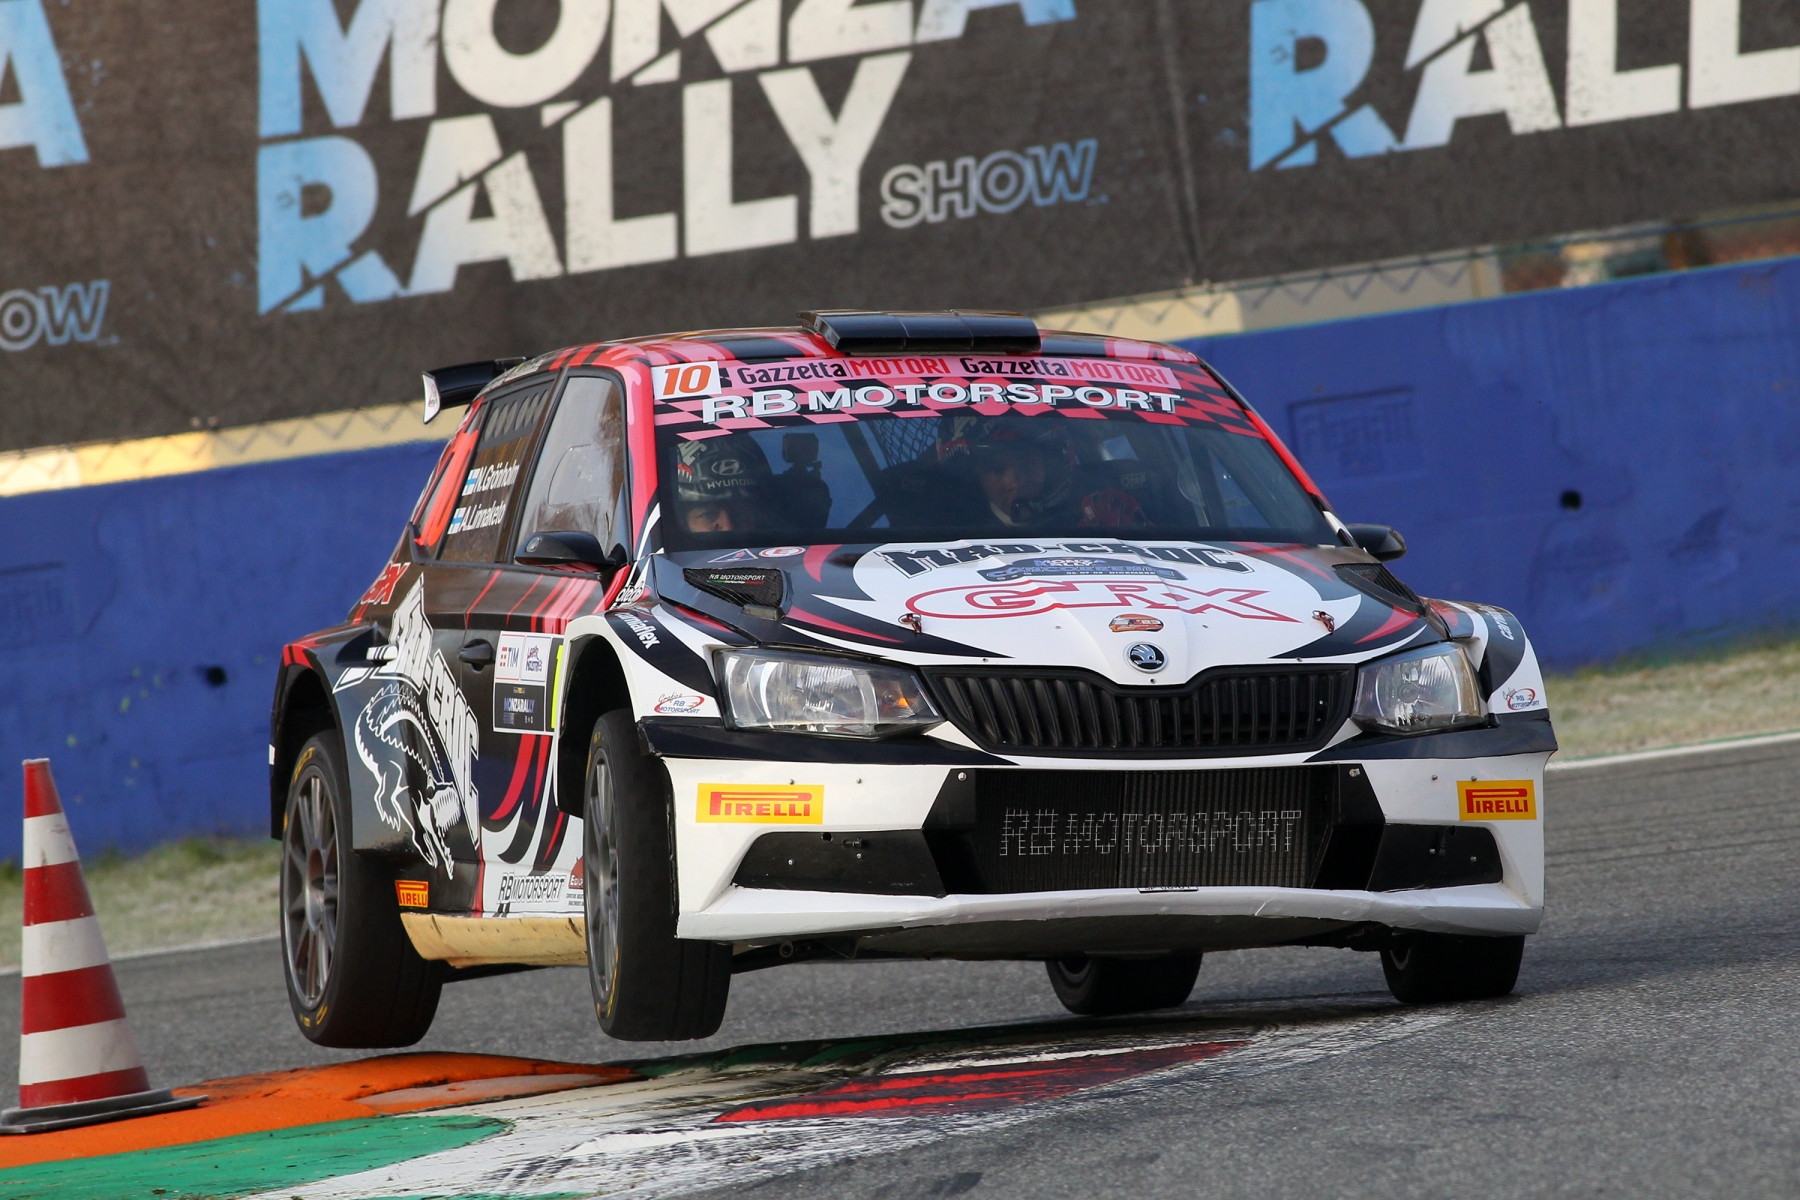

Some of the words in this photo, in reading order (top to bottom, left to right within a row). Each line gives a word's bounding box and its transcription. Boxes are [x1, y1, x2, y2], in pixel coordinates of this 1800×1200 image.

[257, 52, 912, 316] RALLY
[880, 139, 1098, 228] SHOW
[663, 364, 713, 396] 10
[736, 359, 847, 385] Gazzetta
[848, 358, 950, 378] MOTORI
[959, 356, 1068, 377] Gazzetta
[1073, 359, 1168, 386] MOTORI
[702, 389, 799, 424] RB
[808, 382, 1184, 414] MOTORSPORT
[709, 791, 813, 817] PIRELLI
[1465, 788, 1529, 814] PIRELLI
[1000, 809, 1058, 856] RB
[1063, 810, 1302, 855] MOTORSPORT
